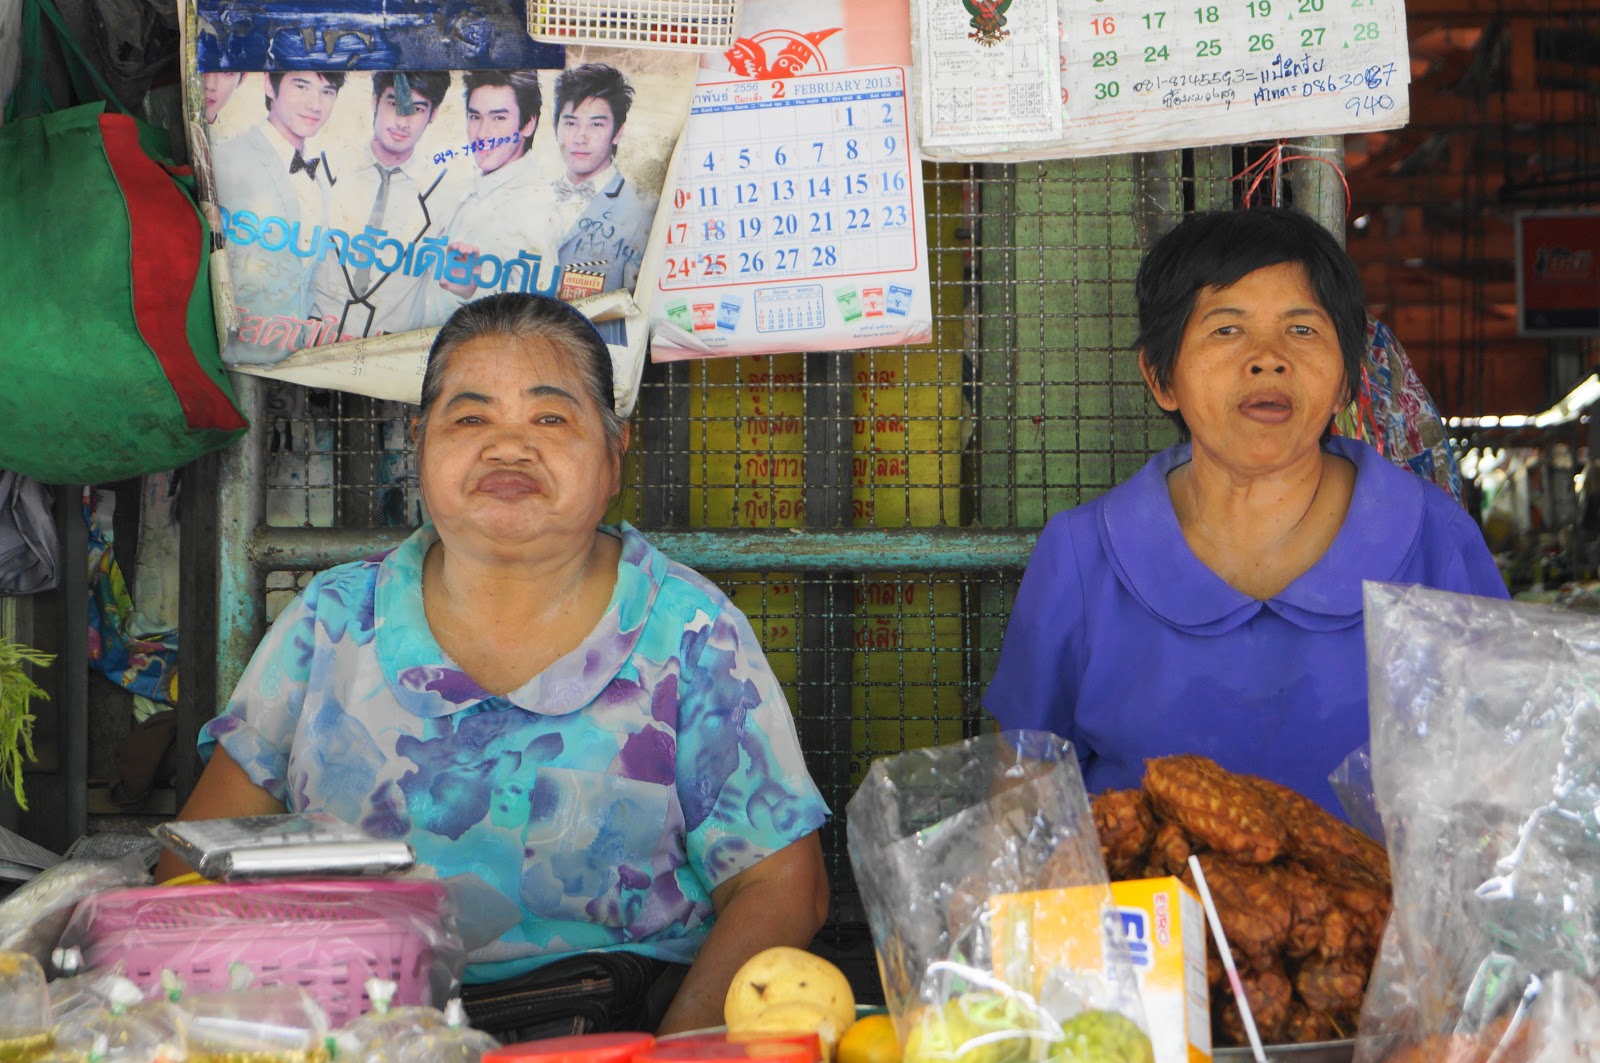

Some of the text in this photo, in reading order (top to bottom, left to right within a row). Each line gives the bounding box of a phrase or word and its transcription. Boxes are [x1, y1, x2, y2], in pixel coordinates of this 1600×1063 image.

[1090, 6, 1219, 36] 16 17 18
[1246, 0, 1271, 18] 19
[1092, 22, 1379, 68] 23 24 25 26 27 28
[734, 82, 758, 93] 2556
[771, 80, 786, 98] 2
[794, 79, 861, 95] FEBRUARY
[865, 76, 892, 89] 2013
[1094, 81, 1119, 100] 30
[846, 103, 893, 126] 1 2
[1345, 95, 1395, 116] 940
[703, 136, 896, 171] 4 5 6 7 8 9
[674, 169, 905, 209] 0 11 12 13 14 15 16
[703, 220, 726, 241] 18
[739, 217, 761, 238] 19
[773, 214, 798, 235] 20
[809, 211, 832, 233] 21
[845, 208, 871, 229] 22
[881, 205, 907, 226] 23
[665, 245, 836, 279] 24 25 26 27 28
[1155, 894, 1169, 945] EURO
